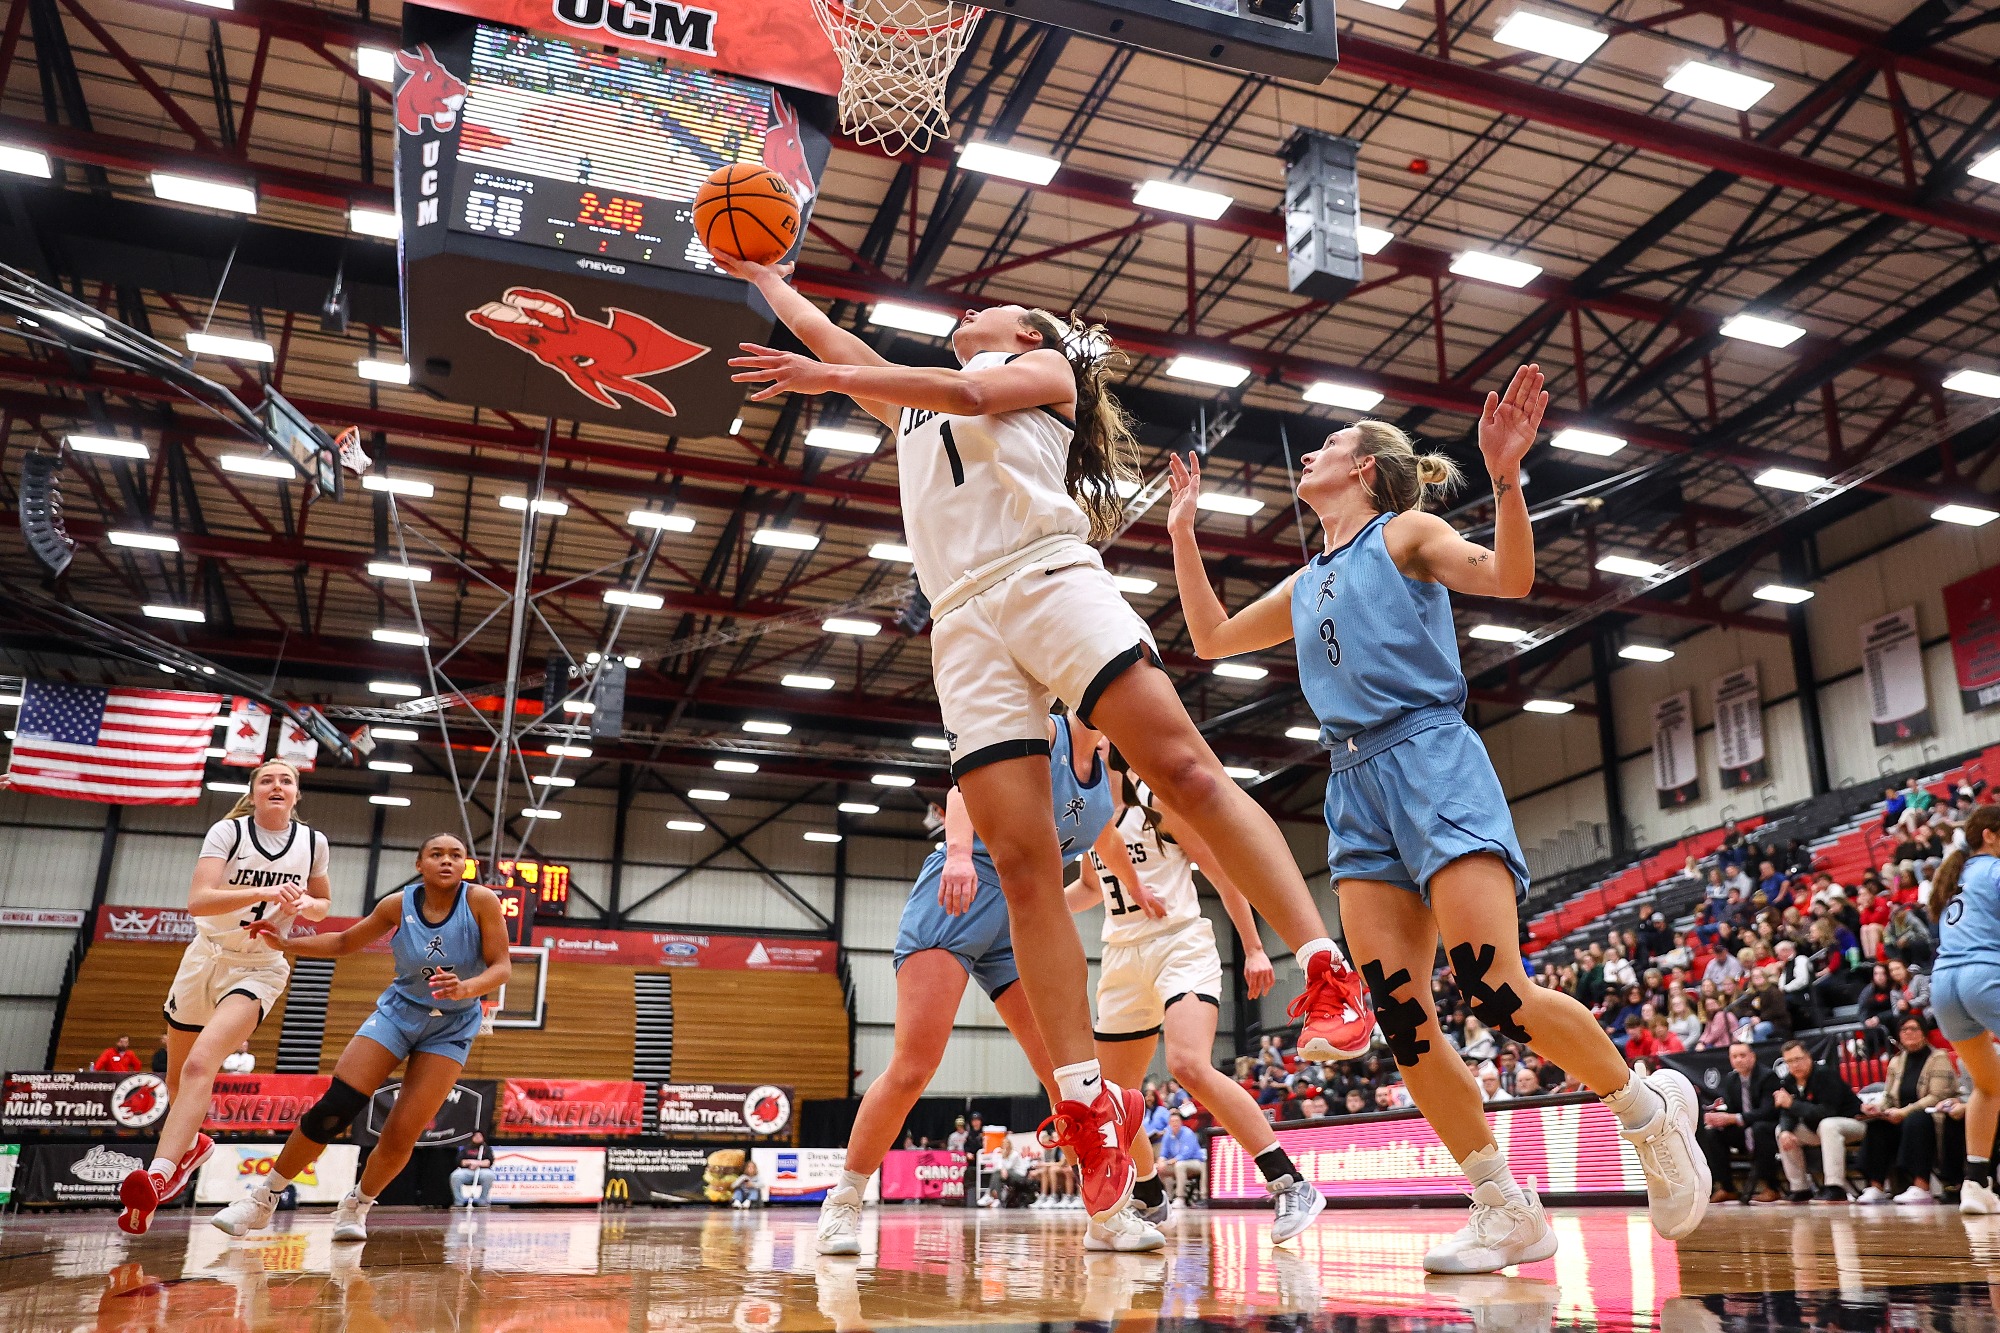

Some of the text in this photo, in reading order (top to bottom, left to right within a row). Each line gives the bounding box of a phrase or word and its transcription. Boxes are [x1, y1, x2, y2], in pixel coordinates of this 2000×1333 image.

[552, 0, 718, 57] UCM
[417, 140, 440, 227] UCM
[939, 419, 965, 488] 1
[1318, 616, 1342, 668] 3
[557, 938, 619, 951] Central Bank
[11, 1074, 76, 1083] Support UCM
[212, 1082, 261, 1094] ENNIES
[10, 1092, 48, 1101] Join the
[4, 1100, 108, 1117] Mule Train.
[205, 1094, 316, 1123] ASKETBA
[504, 1101, 642, 1127] BASKETBALL
[660, 1108, 743, 1124] Mule Train.
